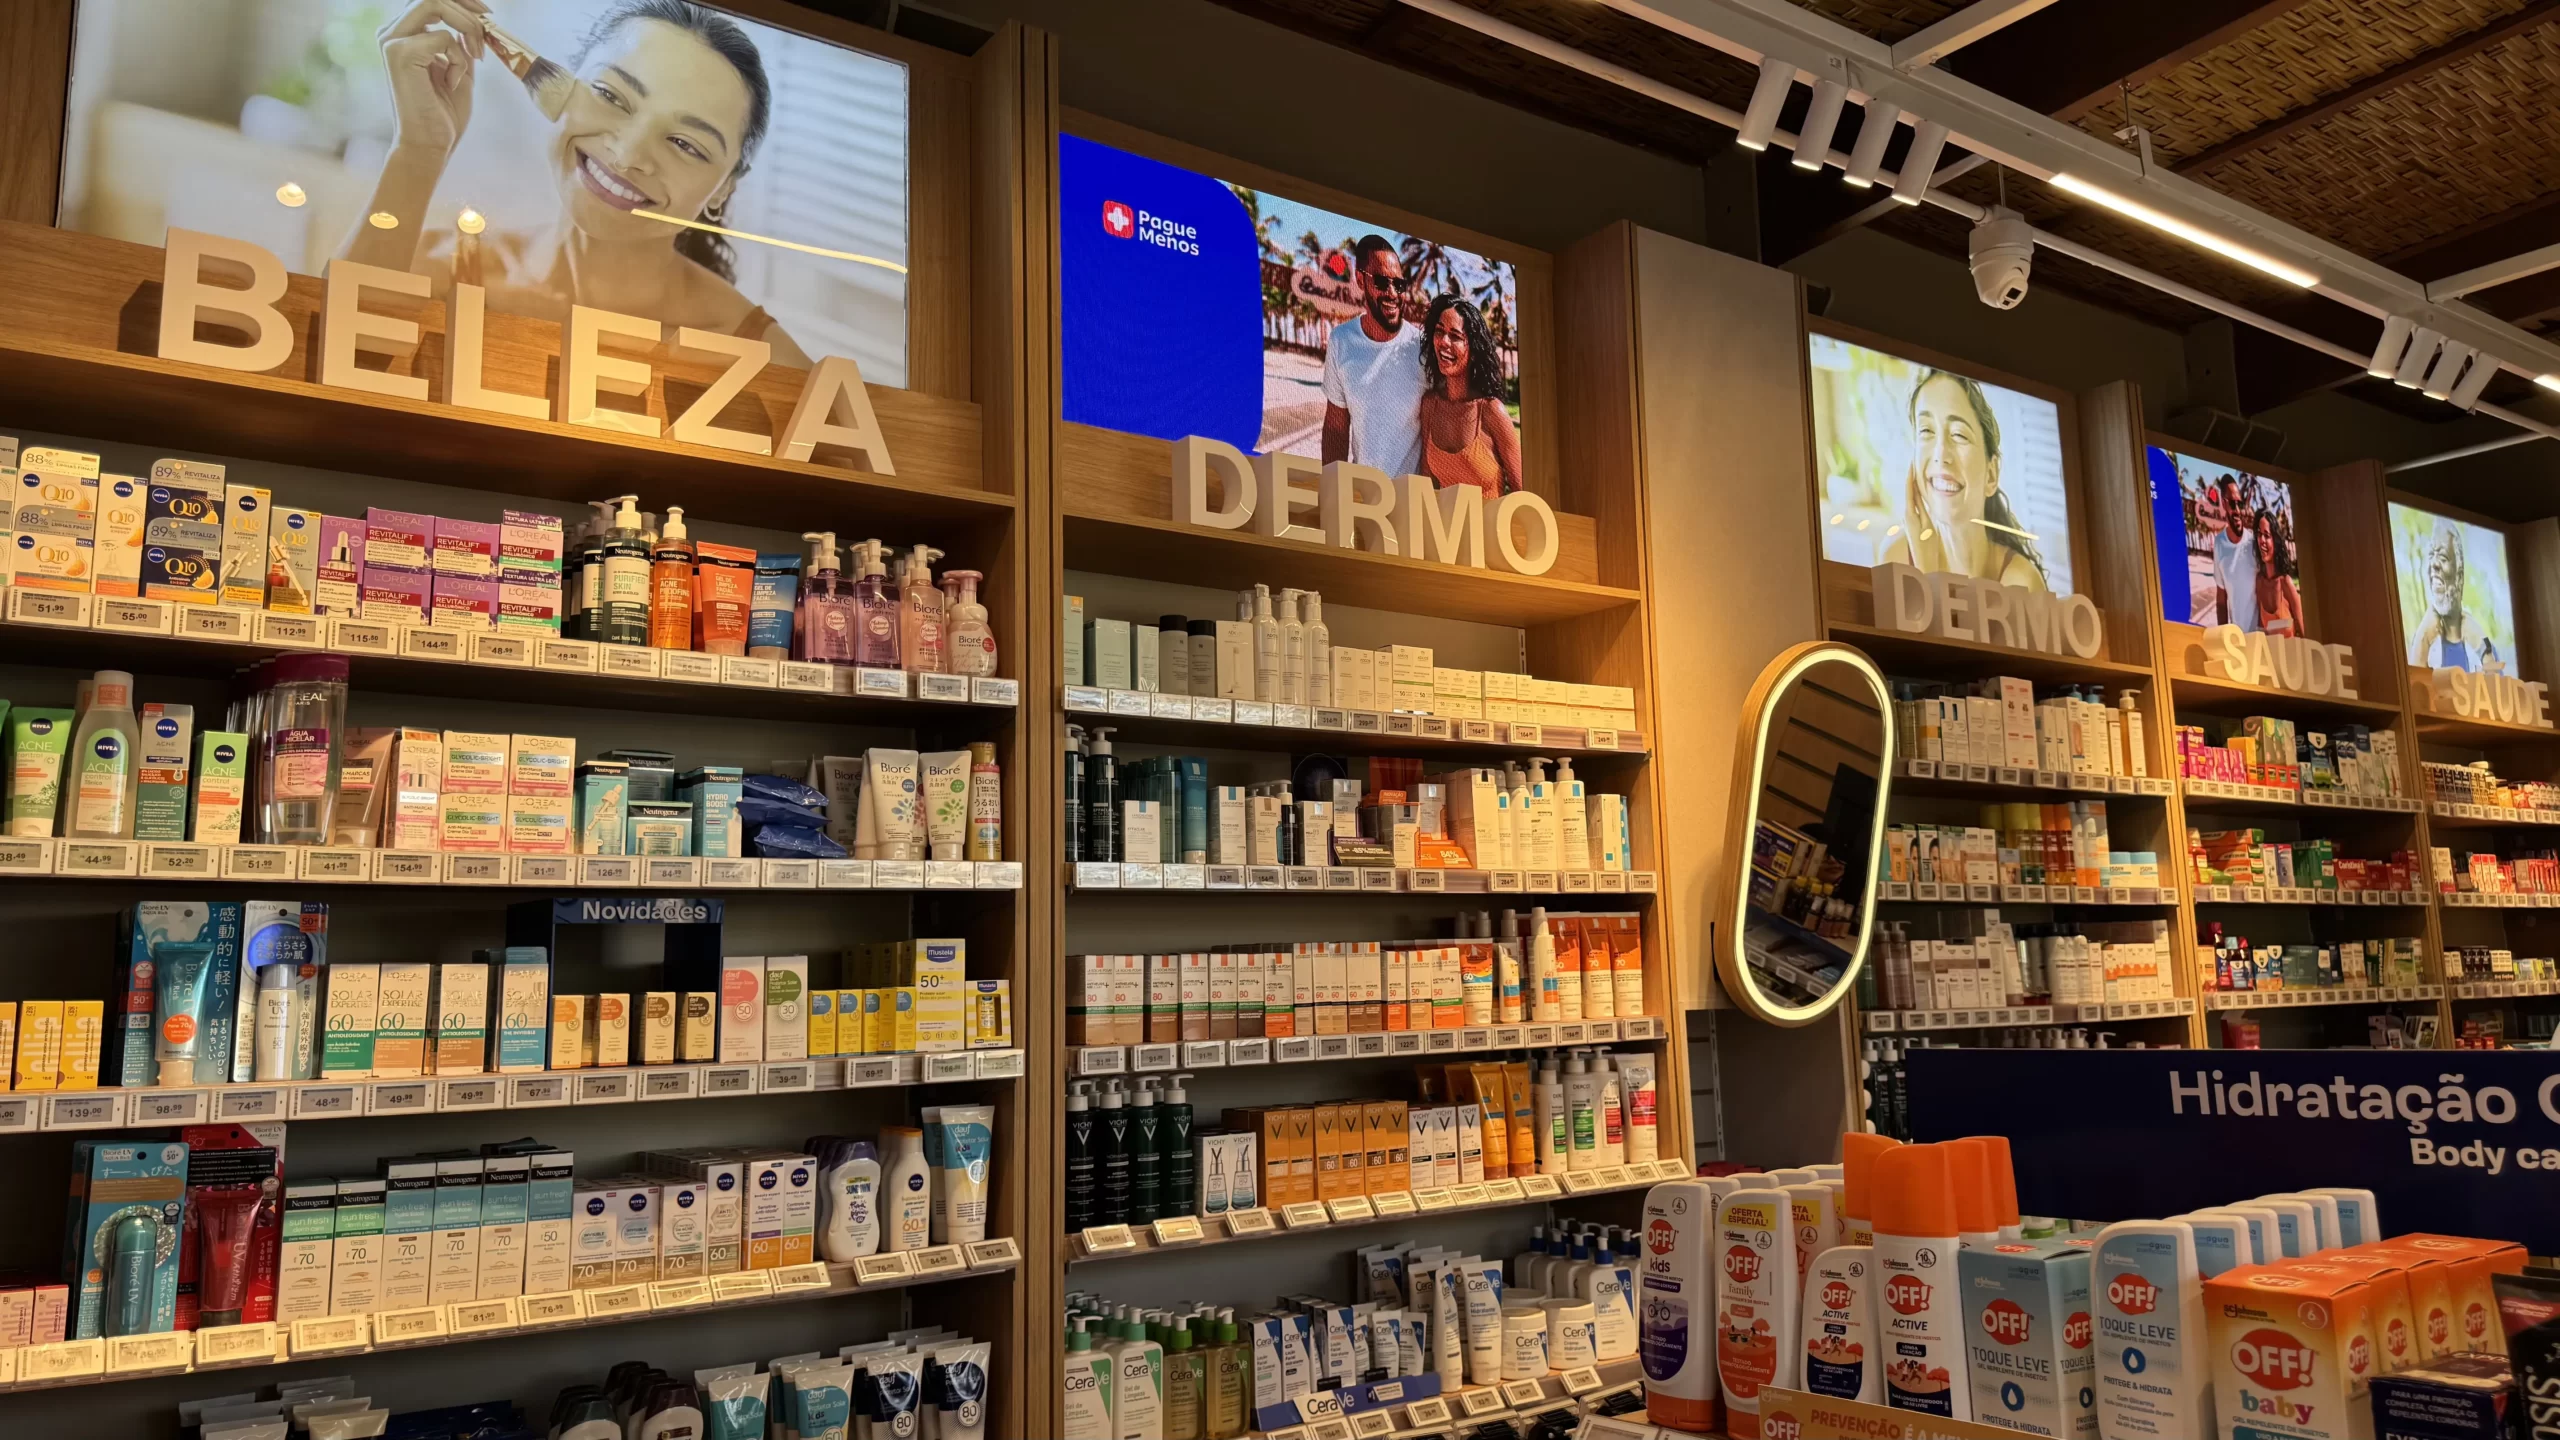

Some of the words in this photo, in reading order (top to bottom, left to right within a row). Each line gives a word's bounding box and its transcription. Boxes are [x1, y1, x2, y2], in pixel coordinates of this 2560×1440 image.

[1139, 210, 1197, 239] Pague
[1139, 226, 1199, 256] Menos
[158, 226, 896, 477] BELEZA
[155, 467, 182, 480] 89%
[184, 471, 221, 480] REVITALIZA
[41, 484, 75, 503] Q10
[169, 498, 202, 516] Q10
[1172, 435, 1560, 576] DERMO
[20, 511, 49, 525] 88%
[151, 525, 178, 539] 89%
[180, 530, 218, 540] REVITALIZA
[35, 545, 70, 563] Q10
[502, 545, 544, 557] REVITALIFT
[165, 558, 197, 577] Q10
[613, 574, 646, 585] PURIFIED
[660, 580, 678, 588] ACNE
[613, 583, 632, 591] SKIN
[366, 589, 411, 601] REVITALIFT
[37, 604, 65, 613] 51,99
[435, 597, 479, 608] REVITALIFT
[501, 604, 543, 614] REVITALIFT
[913, 602, 943, 616] Bioré
[121, 612, 148, 621] 55,00
[1872, 562, 2102, 660] DERMO
[201, 619, 227, 629] 51,99
[958, 634, 983, 646] Bioré
[31, 722, 51, 731] NIVEA
[157, 724, 178, 733] NIVEA
[17, 741, 53, 752] ACNE
[97, 743, 119, 753] NIVEA
[215, 751, 235, 759] NIVEA
[86, 762, 122, 773] ACNE
[203, 767, 237, 777] ACNE
[880, 762, 911, 775] Bioré
[929, 764, 961, 776] Bioré
[706, 792, 729, 801] HYDRO
[706, 800, 728, 809] BOOST
[643, 807, 679, 817] Neutrogena
[168, 857, 195, 868] 52,20
[247, 860, 273, 870] 51,99
[466, 864, 489, 875] 81,99
[582, 901, 707, 920] Novidades
[928, 949, 956, 957] Mustela
[725, 969, 744, 980] dauf
[383, 988, 423, 1000] SOLAR
[1153, 992, 1163, 1001] 80
[737, 1004, 751, 1015] 50
[782, 1004, 796, 1015] 30
[314, 1096, 341, 1108] 48,99
[460, 1090, 484, 1101] 49,99
[2169, 1070, 2517, 1134] Hidratação
[67, 1106, 103, 1119] 139,00
[155, 1103, 183, 1115] 98,99
[236, 1100, 264, 1112] 74,99
[1073, 1121, 1093, 1130] VICHY
[1109, 1118, 1128, 1127] VICHY
[1139, 1117, 1159, 1126] VICHY
[1174, 1115, 1192, 1123] VICHY
[2411, 1138, 2505, 1175] Body
[490, 1173, 525, 1183] Neutrogena
[536, 1169, 569, 1179] Neutrogena
[394, 1180, 430, 1190] Neutrogena
[442, 1176, 477, 1186] Neutrogena
[343, 1193, 380, 1204] Neutrogena
[358, 1211, 380, 1222] fresh
[1731, 1207, 1763, 1218] OFERTA
[307, 1216, 329, 1226] fresh
[902, 1218, 919, 1232] 60
[544, 1230, 558, 1242] 50
[1646, 1228, 1677, 1252] OFF!
[753, 1241, 769, 1254] 60
[784, 1237, 800, 1250] 60
[299, 1252, 315, 1265] 70
[350, 1247, 367, 1260] 70
[710, 1247, 726, 1260] 60
[620, 1260, 637, 1273] 70
[669, 1256, 685, 1269] 70
[1650, 1257, 1671, 1273] kids
[1724, 1253, 1761, 1280] OFF!
[1468, 1279, 1500, 1292] CeraVe
[1596, 1279, 1632, 1294] CeraVe
[1729, 1283, 1755, 1299] family
[608, 1297, 629, 1307] 63,99
[1821, 1288, 1852, 1306] OFF!
[1885, 1283, 1931, 1311] OFF!
[2107, 1281, 2156, 1312] OFF!
[542, 1304, 564, 1315] 76,99
[1822, 1310, 1850, 1320] ACTIVE
[400, 1319, 424, 1331] 81,99
[1892, 1318, 1928, 1331] ACTIVE
[1981, 1308, 2029, 1342] OFF!
[2465, 1309, 2486, 1330] OFF!
[1563, 1325, 1595, 1338] CeraVe
[2099, 1315, 2137, 1335] TOQUE
[2139, 1323, 2176, 1341] LEVE
[1972, 1347, 2014, 1368] TOQUE
[2016, 1355, 2050, 1374] LEVE
[2060, 1356, 2085, 1370] TOQUE
[2231, 1340, 2315, 1386] OFF!
[2349, 1343, 2370, 1370] OFF!
[1124, 1361, 1160, 1377] CeraVe
[1220, 1359, 1248, 1373] CeraVe
[1170, 1367, 1203, 1382] CeraVe
[1987, 1364, 2014, 1377] REPELENTE
[2024, 1372, 2048, 1382] INSETOS
[1065, 1373, 1110, 1391] CeraVe
[2103, 1375, 2132, 1390] PROTEGE
[2139, 1383, 2174, 1396] HIDRATA
[1307, 1393, 1354, 1415] CeraVe
[2239, 1389, 2315, 1425] baby
[962, 1405, 977, 1418] 80
[897, 1415, 912, 1429] 80
[1811, 1409, 1900, 1439] PREVENÇÃO
[1982, 1413, 2012, 1429] PROTEGE
[2020, 1421, 2051, 1437] HIDRATA
[2246, 1418, 2286, 1432] REPELENTE
[2299, 1428, 2330, 1438] INSETOS
[1764, 1418, 1800, 1440] OFF!
